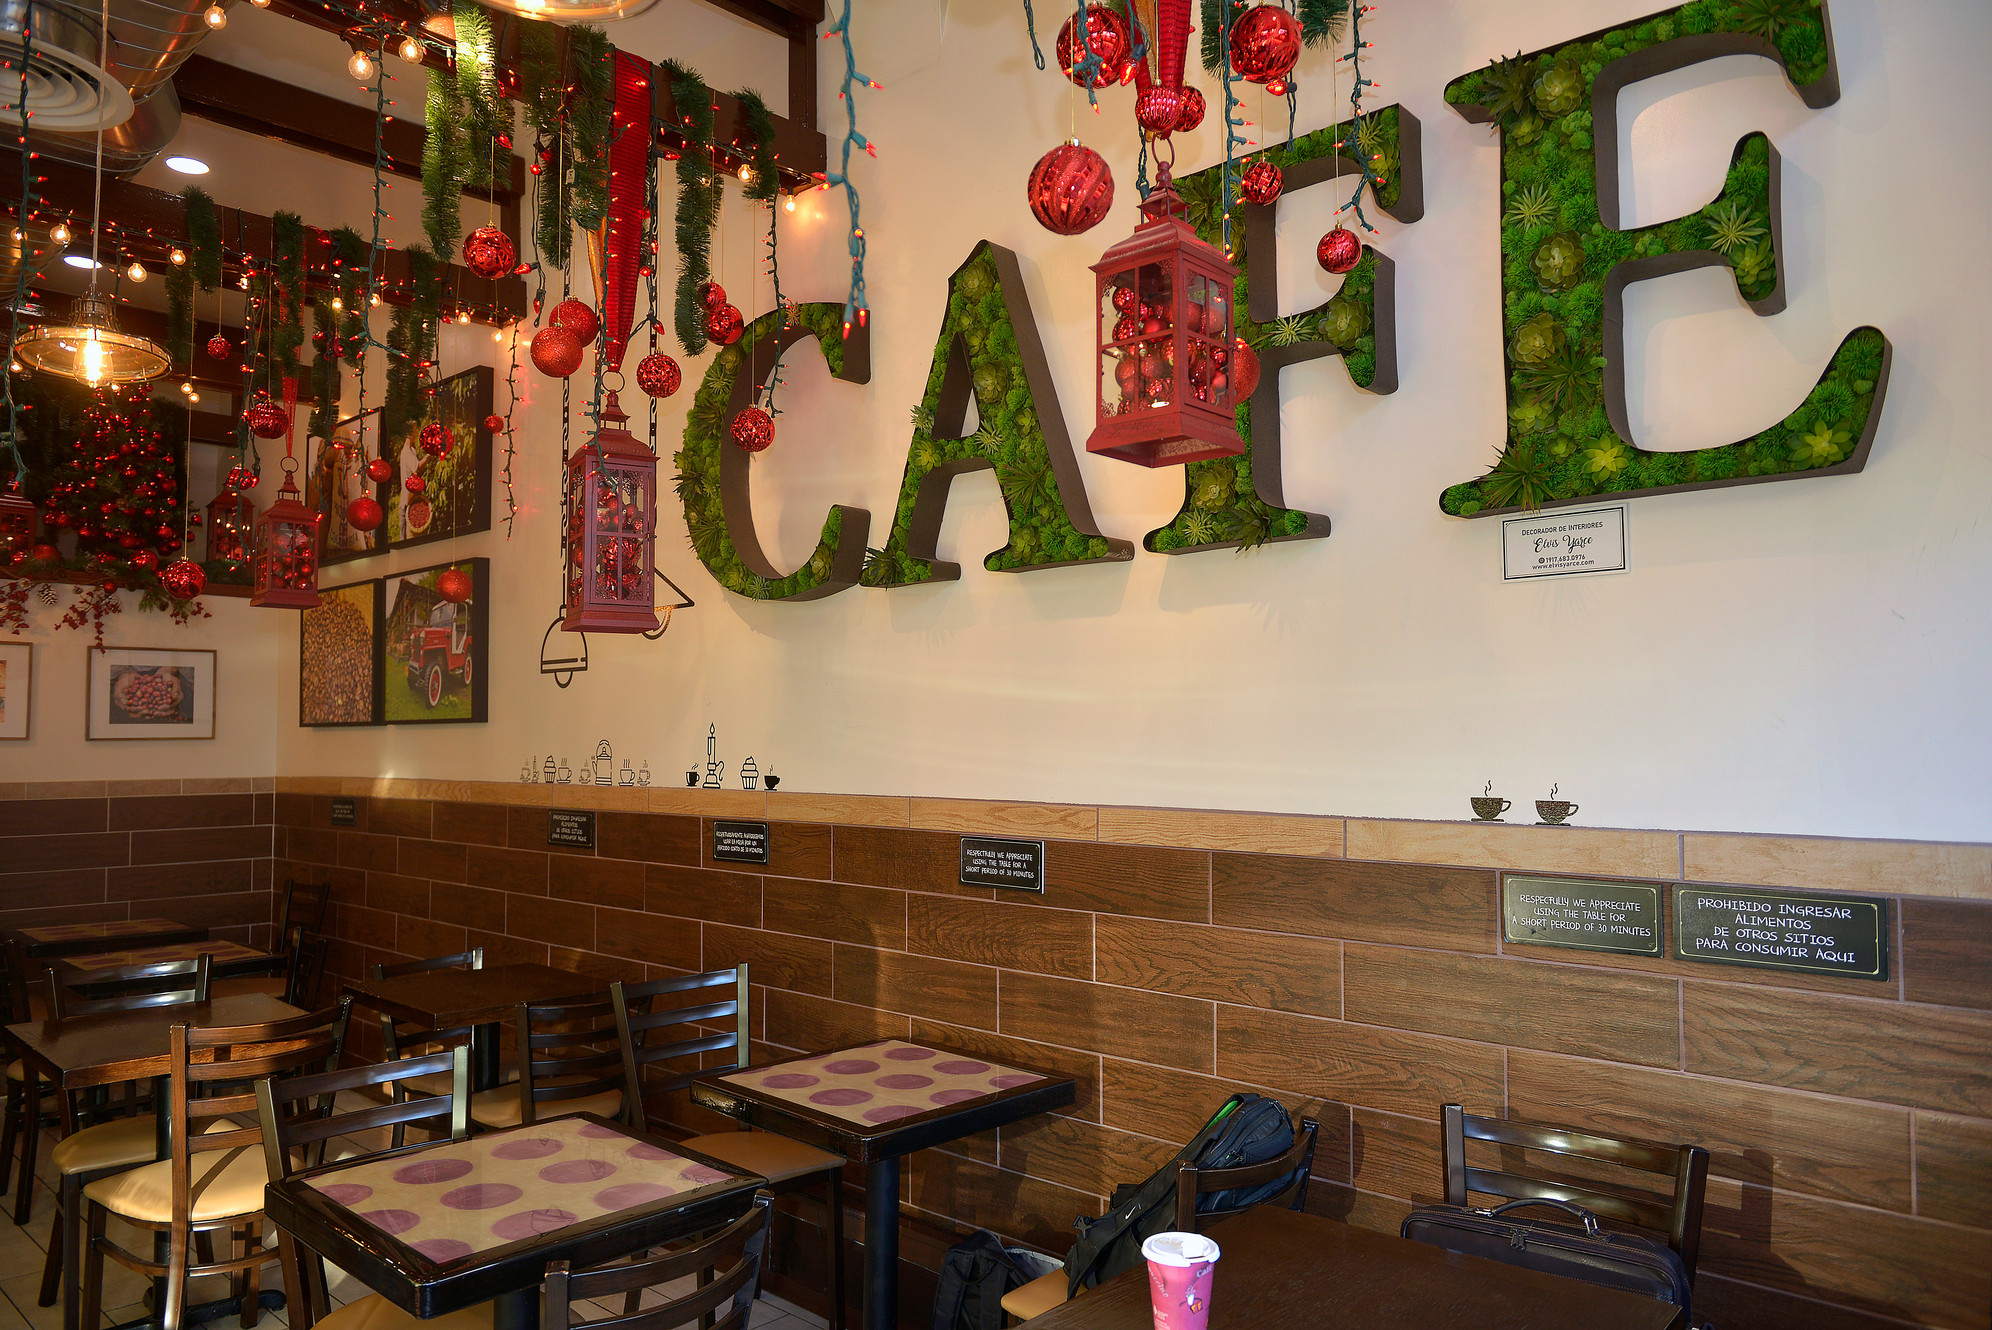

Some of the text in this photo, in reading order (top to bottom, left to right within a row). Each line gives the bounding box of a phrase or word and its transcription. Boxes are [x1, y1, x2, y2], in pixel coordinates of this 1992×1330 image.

[1522, 527, 1556, 536] DECORADOR
[1568, 522, 1603, 531] INTERIORES
[1533, 535, 1592, 554] Elvis Yarce
[1532, 560, 1594, 570] www.elvisyarce.com
[966, 849, 996, 859] RESPECTFULLY
[1006, 852, 1033, 861] APPRECIATE
[1520, 894, 1640, 911] RESPECTFULLY WE APPRECIATE
[1698, 898, 1851, 919] PROHIBIDO INGRESAR
[1534, 908, 1626, 922] USING THE TABLE FOR
[1735, 914, 1812, 930] ALIMENTOS
[1512, 916, 1517, 924] A
[1521, 918, 1546, 927] SHORT
[1551, 920, 1580, 930] PERIOD
[1598, 924, 1607, 932] 30
[1611, 926, 1650, 937] MINUTES
[1714, 926, 1835, 946] DE OTROS SITIOS
[1696, 938, 1856, 963] PARA CONSUMIR AQUI
